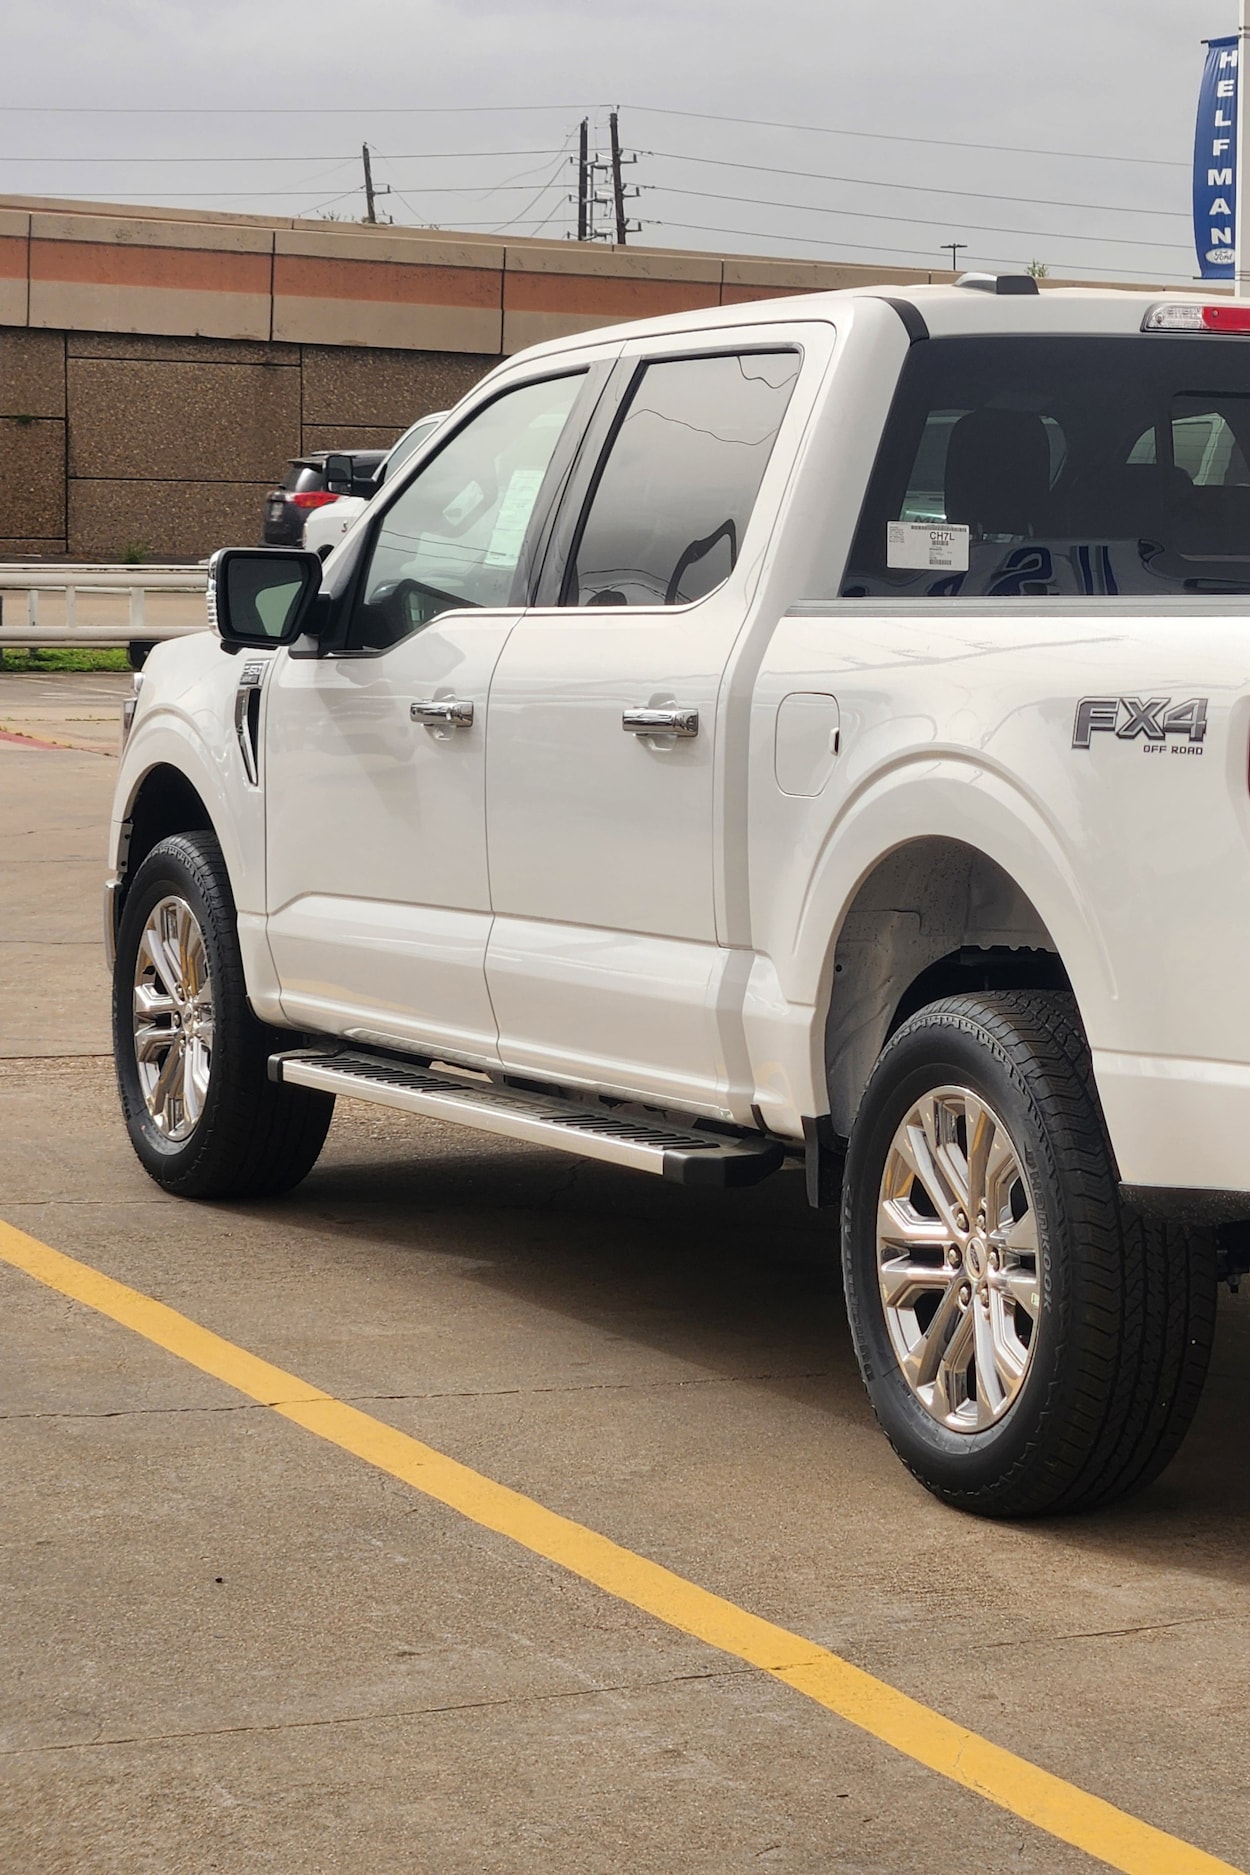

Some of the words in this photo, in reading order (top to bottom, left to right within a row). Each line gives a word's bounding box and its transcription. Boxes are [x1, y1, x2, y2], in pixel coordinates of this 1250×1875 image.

[1207, 51, 1238, 245] HELFMAN
[929, 531, 955, 541] CH7L
[1072, 696, 1209, 750] FX4
[1143, 744, 1168, 753] OFF
[1171, 745, 1204, 755] ROAD
